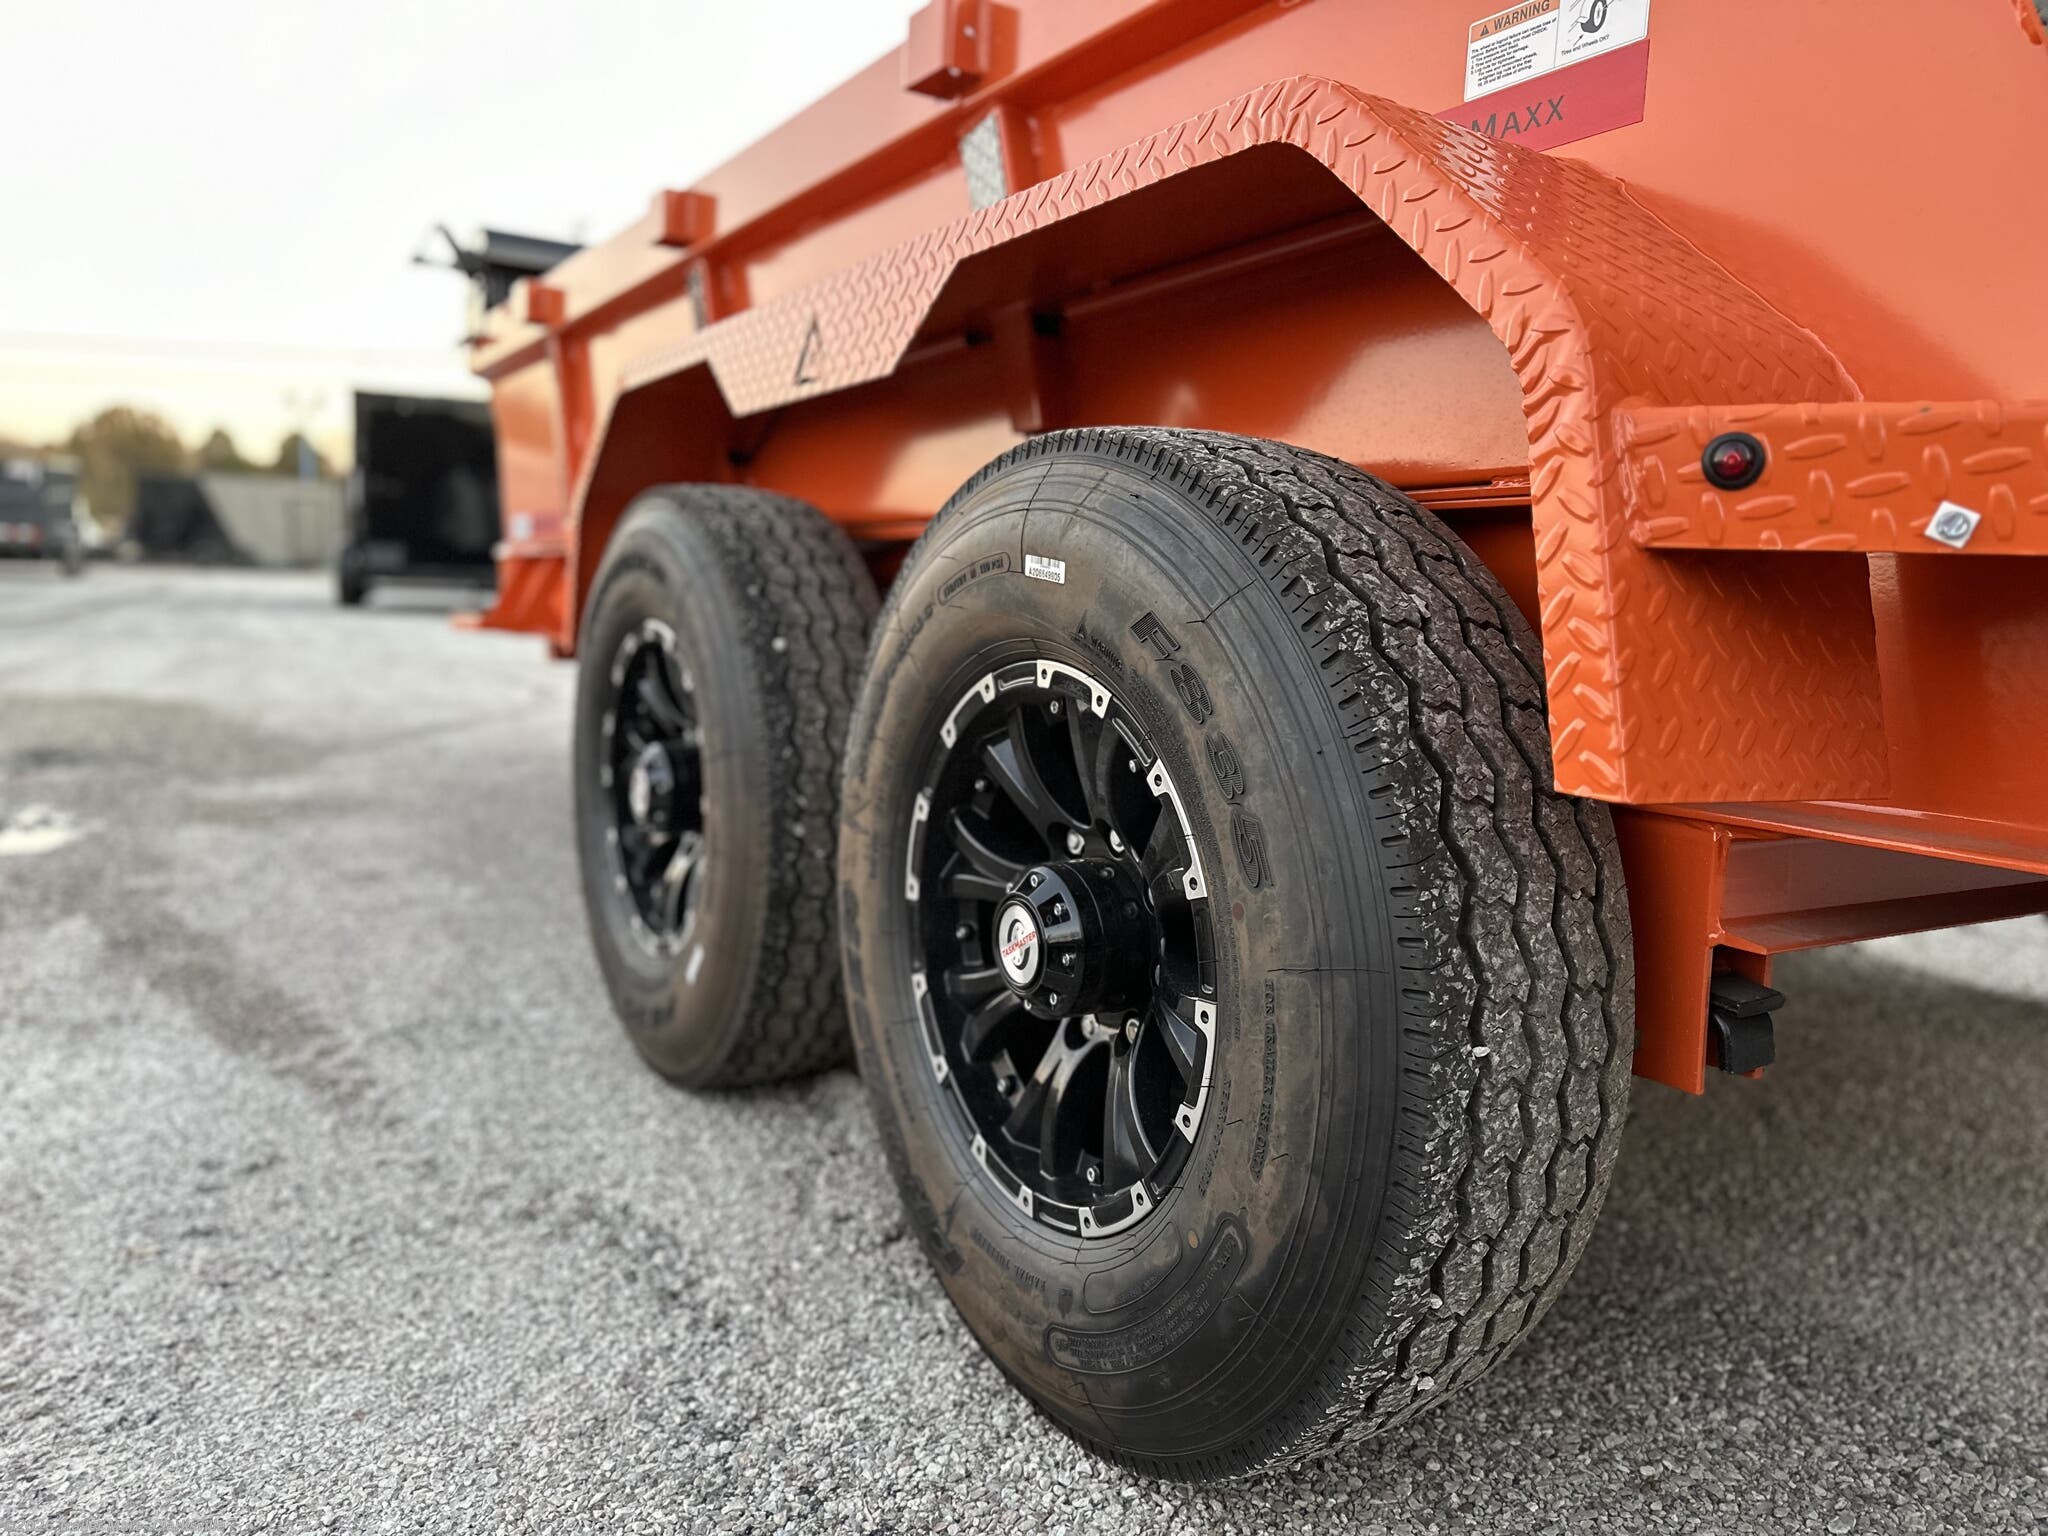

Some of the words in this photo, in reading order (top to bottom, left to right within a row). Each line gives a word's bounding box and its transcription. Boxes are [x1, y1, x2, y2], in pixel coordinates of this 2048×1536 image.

[1494, 0, 1550, 30] WARNING
[1472, 95, 1564, 138] MAXX
[1002, 931, 1037, 957] TASKMASTER
